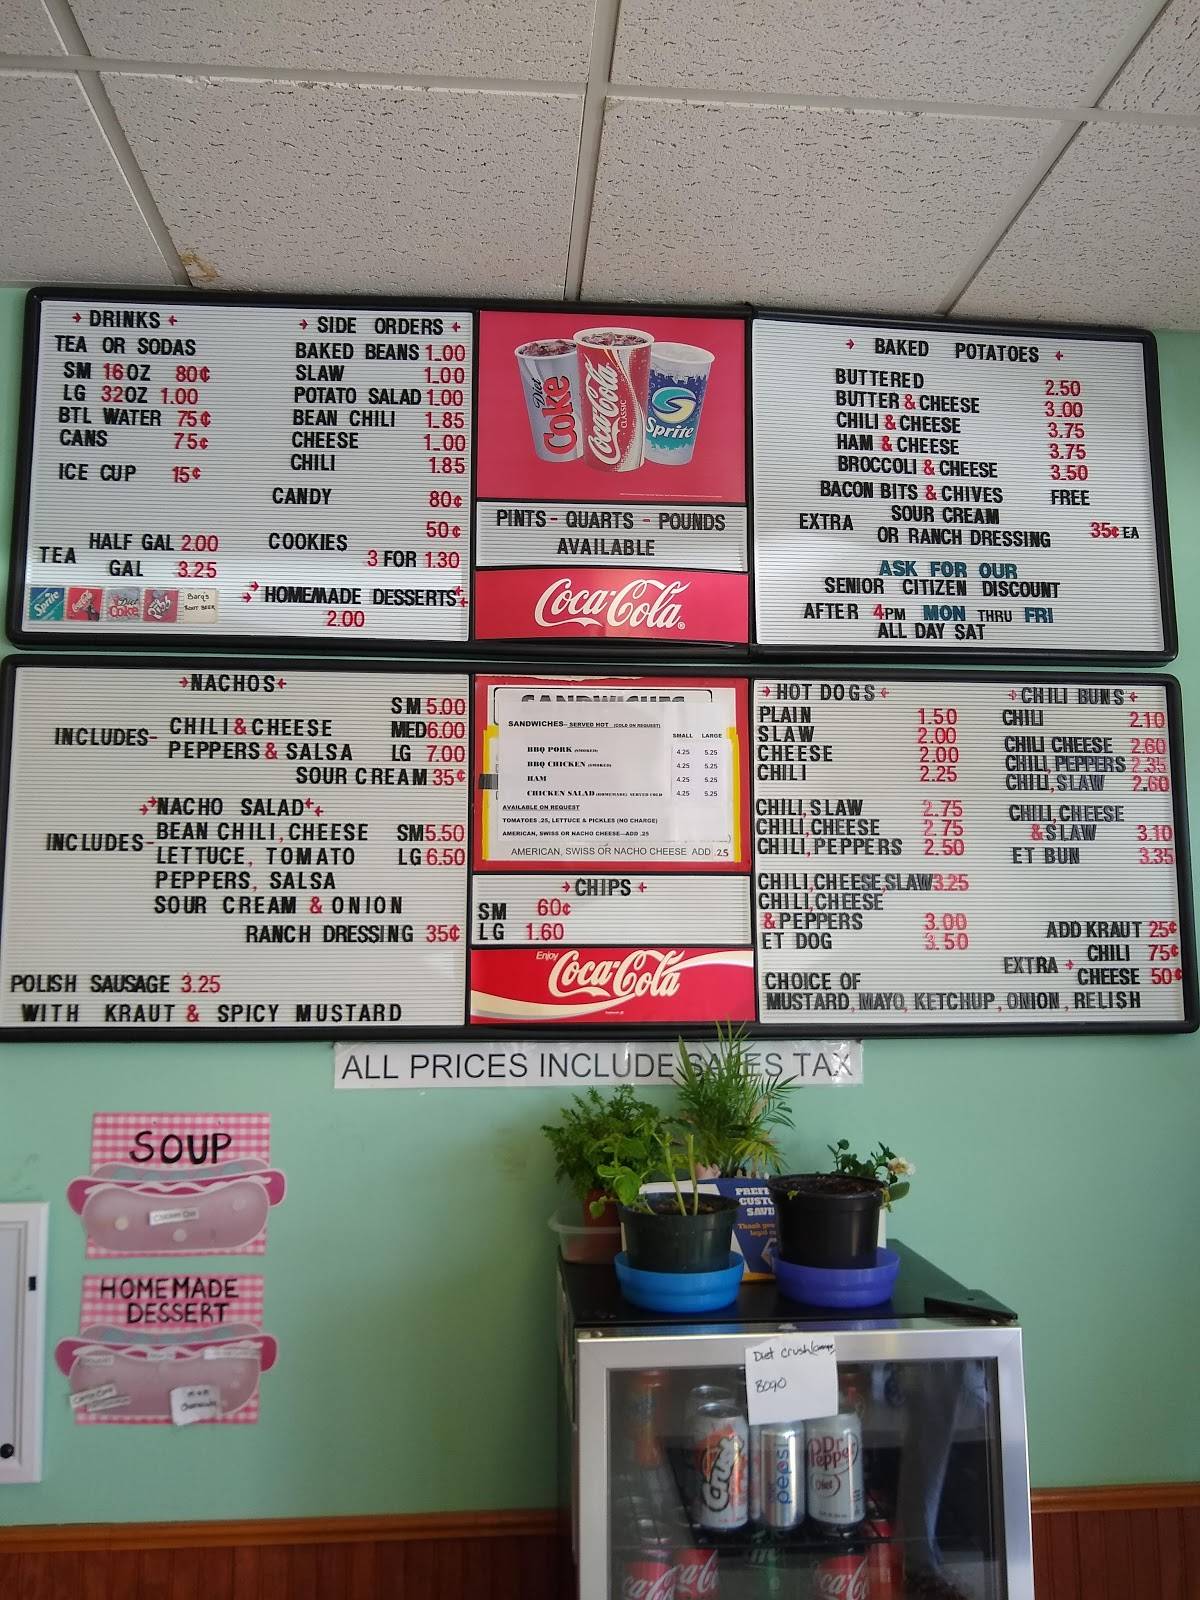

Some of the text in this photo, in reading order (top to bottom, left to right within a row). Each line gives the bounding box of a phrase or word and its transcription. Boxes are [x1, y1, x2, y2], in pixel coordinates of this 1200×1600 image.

[90, 310, 160, 328] DRINKS
[318, 316, 443, 335] SIDE ORDERS
[54, 335, 196, 356] TEA OR SODAS
[296, 342, 419, 360] BAKED BEANS
[873, 338, 1039, 362] BAKED POTATOES
[296, 364, 345, 381] SLAW
[835, 368, 924, 388] BUTTERED
[295, 387, 421, 405] POTATO SALAD
[835, 390, 979, 413] BUTTER CHEESE
[59, 407, 161, 426] BTL WATER
[293, 409, 395, 427] BEAN CHILI
[531, 375, 577, 455] Diet Coke
[646, 417, 694, 439] Sprite
[60, 429, 108, 447] CANS
[837, 434, 959, 455] HAM CHEESE
[59, 463, 136, 481] ICE CUP
[838, 456, 997, 478] BROCCOLI CHEESE
[273, 487, 332, 505] CANDY
[820, 481, 1090, 505] BACON BITS CHIVES FREE
[497, 509, 725, 531] PINTS QUARTS POUNDS
[798, 513, 853, 530] EXTRA
[891, 505, 999, 524] SOUR CREAM
[89, 533, 218, 552] HALF GAL 2.00
[269, 533, 347, 551] COOKIES
[906, 528, 1050, 547] RANCH DRESSING
[38, 547, 76, 563] TEA
[556, 538, 655, 556] AVAILABLE
[109, 560, 216, 578] GAL 3.25
[879, 560, 1017, 579] ASK FOR OUR
[264, 586, 458, 606] HOMEMADE DESSERTS
[825, 577, 1060, 598] SENIOR CITIZEN DISCOUNT
[34, 591, 60, 616] Sprite
[803, 603, 1053, 623] AFTER MON THRU FRI
[877, 623, 985, 640] ALL DAY SAT
[188, 674, 275, 692] NACHOS
[774, 683, 875, 701] HOT DOGS
[1019, 687, 1124, 705] CHILI BUNS
[759, 706, 958, 725] PLAIN 1.50
[1000, 709, 1046, 726] CHILI
[758, 726, 956, 744] SLAW 2.00
[168, 741, 352, 760] PEPPERS SALSA
[758, 745, 832, 762] CHEESE
[758, 764, 957, 782] CHILI 2.25
[155, 797, 303, 816] NACHO SALAD
[266, 847, 354, 865] TOMATO
[511, 847, 711, 856] AMERICAN, SWISS OR NACHO CHEESE ADD
[574, 879, 631, 896] CHIPS
[154, 896, 402, 914] SOUR CREAM ONION
[478, 903, 506, 920] SM
[246, 925, 413, 943] RANCH DRESSING
[479, 923, 564, 940] LG 1.60
[536, 951, 559, 961] Enjoy
[11, 975, 220, 993] POLISH SAUSAGE 3.25
[765, 972, 861, 990] CHOICE OF
[1074, 991, 1140, 1009] RELISH
[21, 1004, 401, 1022] WITH KRAUT SPICY MUSTARD
[342, 1051, 854, 1079] ALL PRICES INCLUDE TAX
[129, 1130, 232, 1165] SOUP
[101, 1277, 239, 1299] HOMEMADE
[127, 1303, 229, 1323] DESSERT
